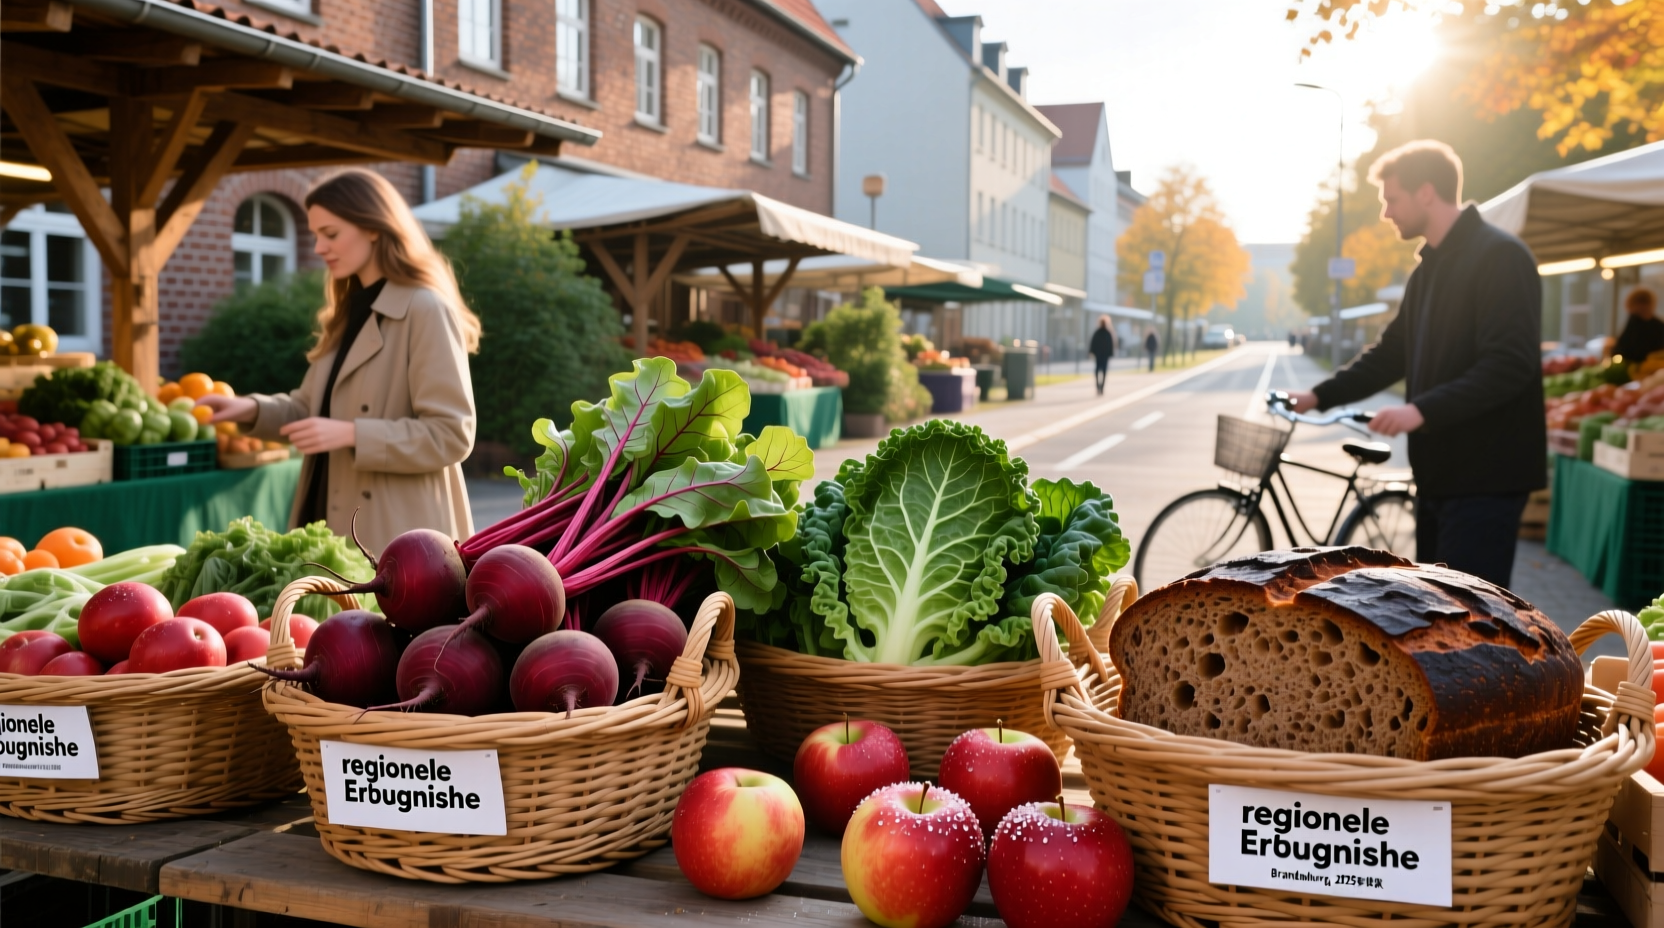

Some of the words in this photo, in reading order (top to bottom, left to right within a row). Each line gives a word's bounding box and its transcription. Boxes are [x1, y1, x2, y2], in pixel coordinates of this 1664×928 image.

[0, 712, 55, 735] ionele
[342, 753, 452, 783] regionele
[344, 778, 481, 813] Erbugnishe
[1242, 801, 1390, 835] regionele
[1240, 828, 1420, 870] Erbugnishe
